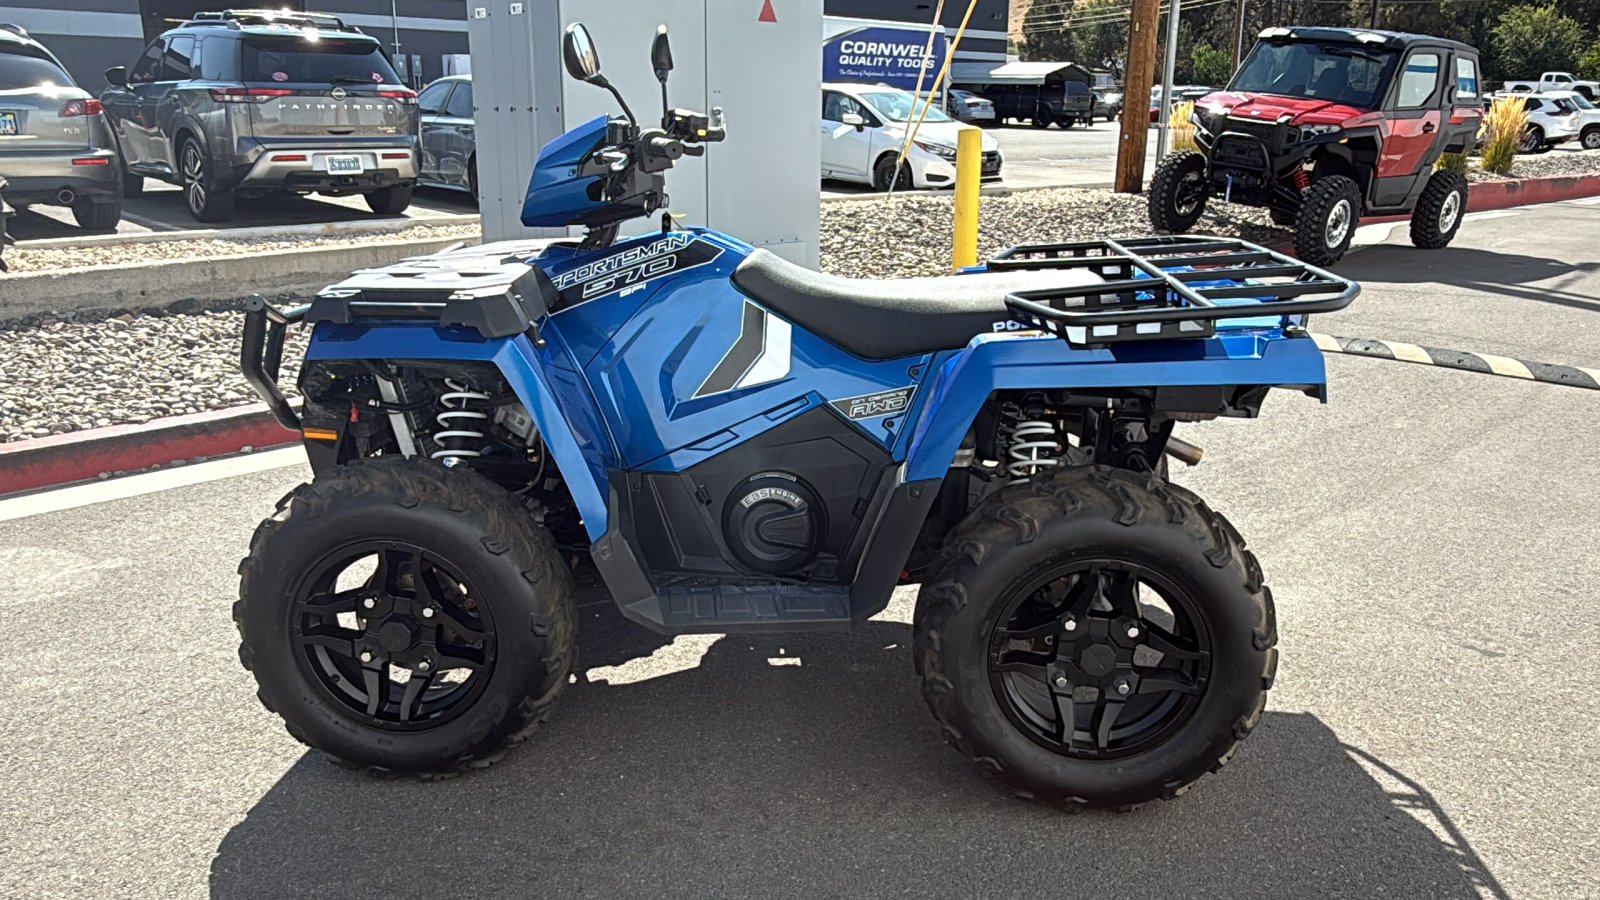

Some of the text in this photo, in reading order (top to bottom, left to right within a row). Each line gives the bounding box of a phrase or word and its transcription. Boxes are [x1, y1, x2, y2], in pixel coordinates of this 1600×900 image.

[841, 41, 936, 58] CORNWELL
[840, 55, 893, 67] QUALITY
[582, 253, 677, 299] 570
[619, 283, 647, 297] EFI
[849, 395, 907, 418] AWD
[744, 489, 769, 505] EBS
[770, 488, 801, 504] ENGINE
